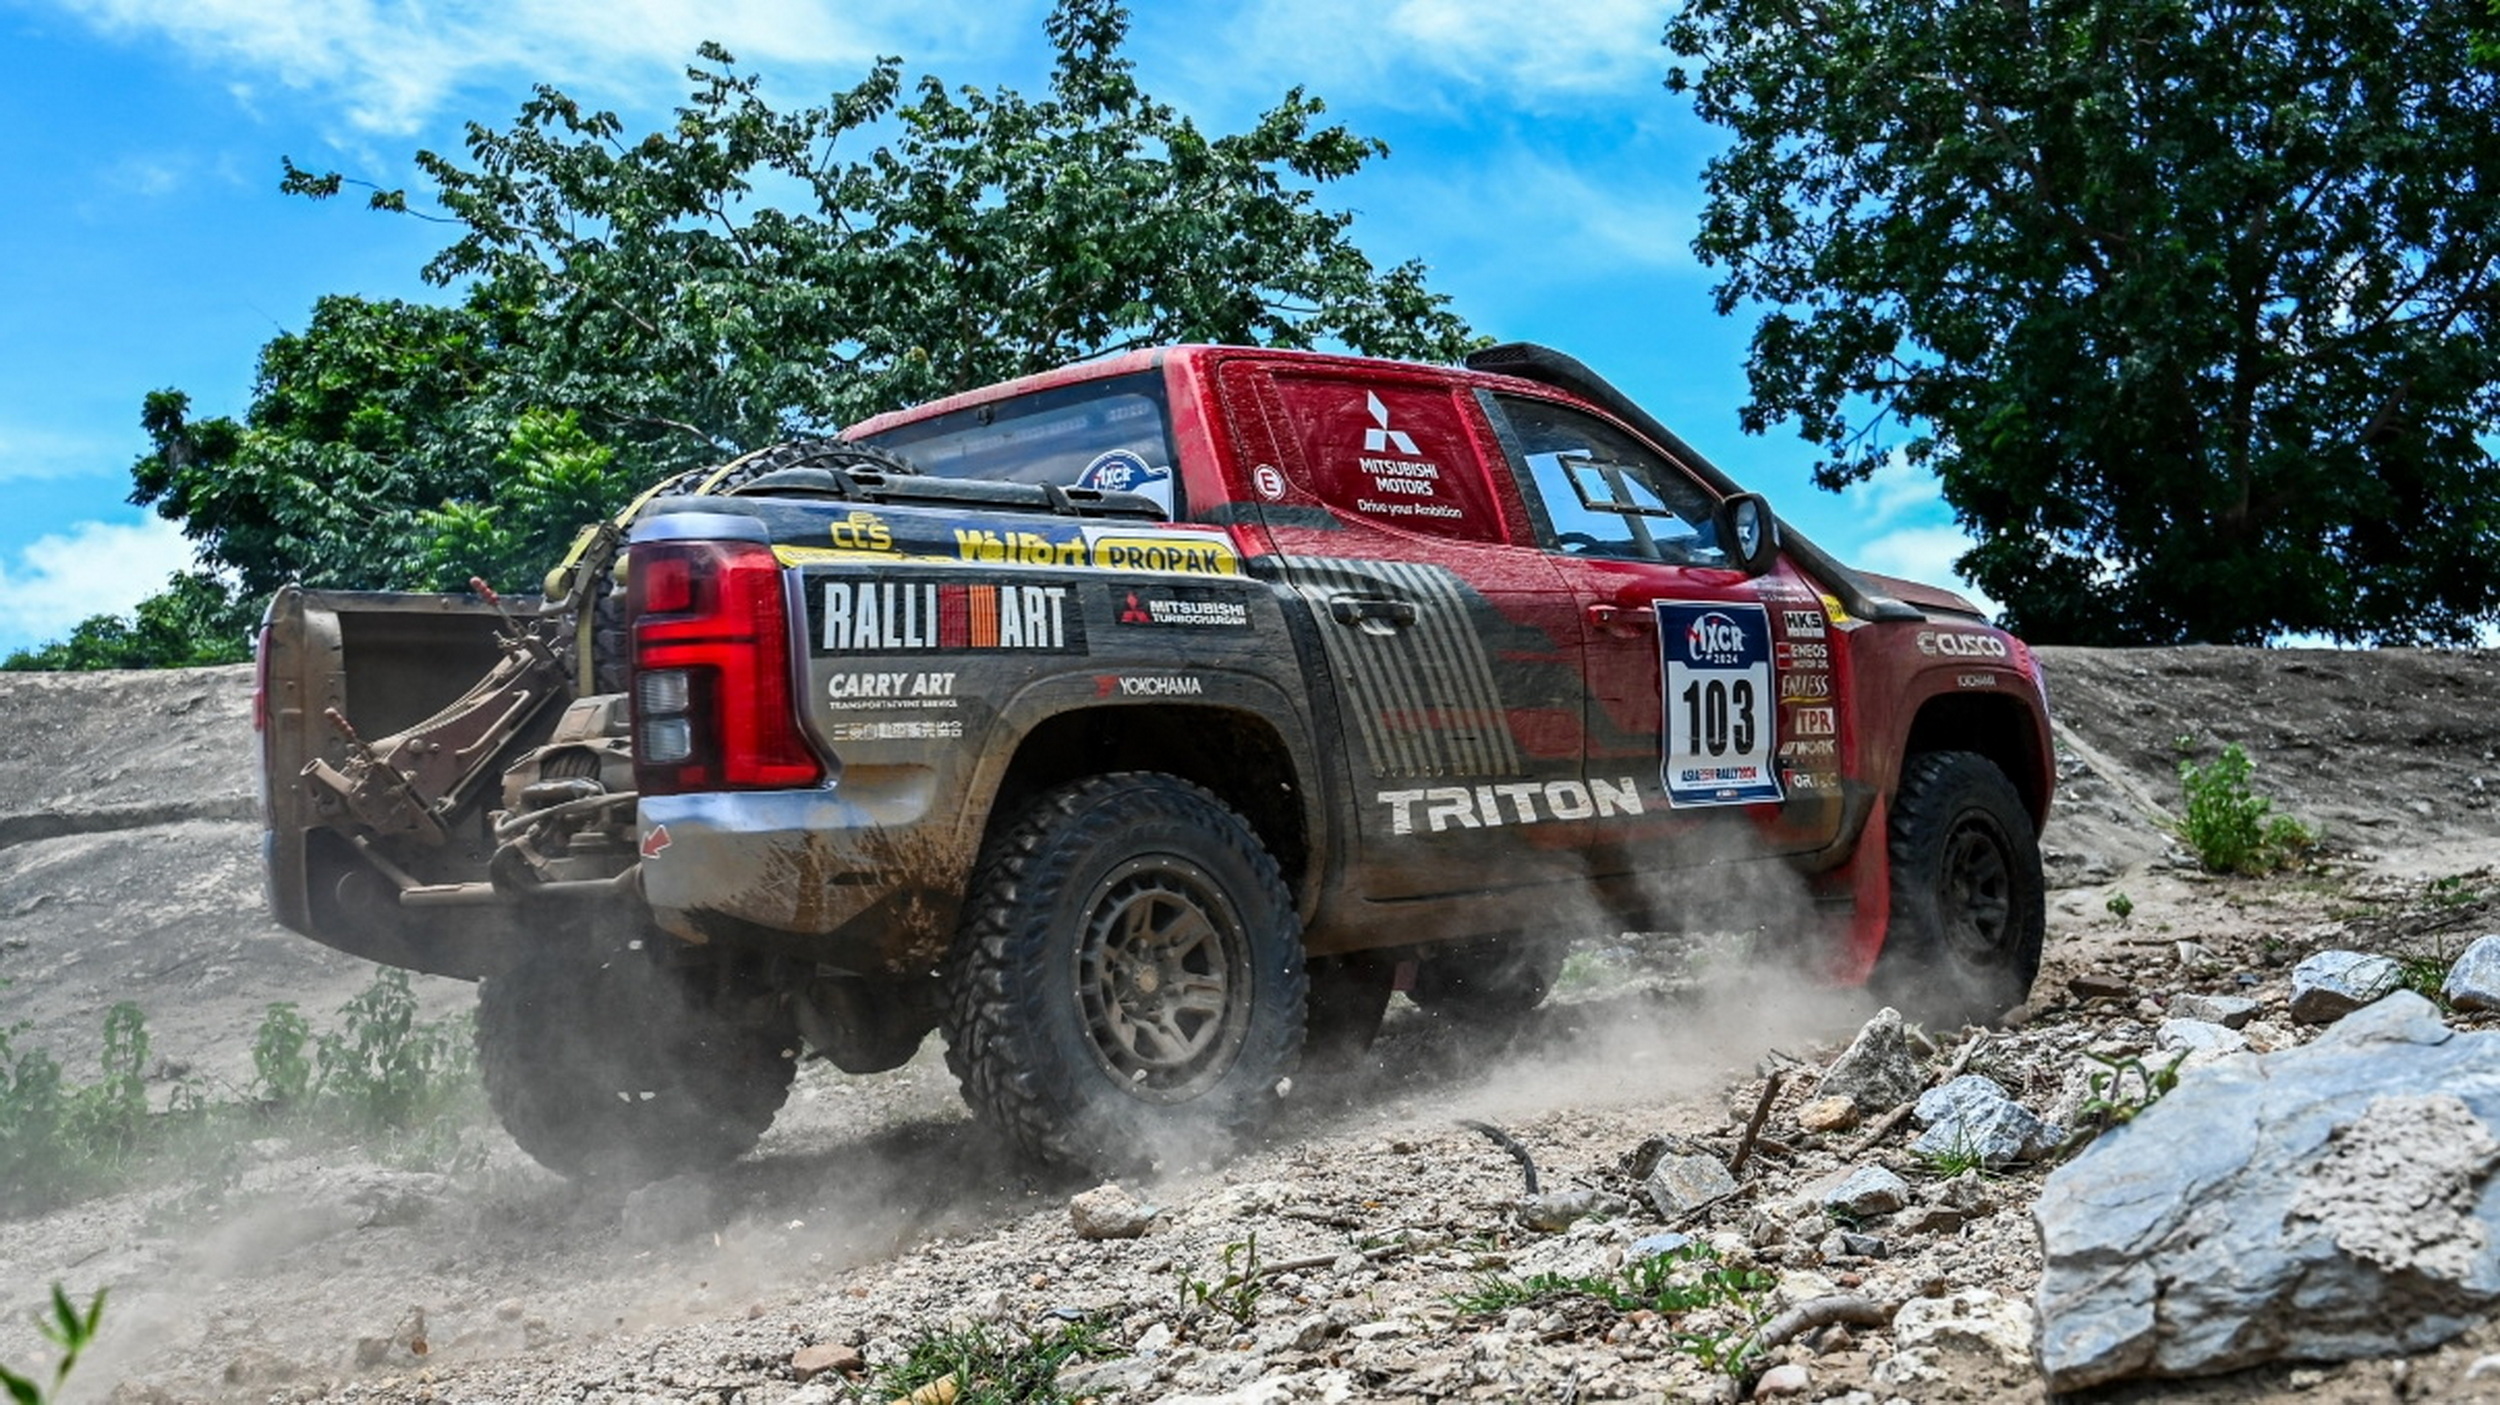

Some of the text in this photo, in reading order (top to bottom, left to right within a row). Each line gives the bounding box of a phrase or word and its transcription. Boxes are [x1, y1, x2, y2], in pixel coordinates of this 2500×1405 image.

[1359, 457, 1439, 479] MITSUBISHI
[1374, 476, 1433, 496] MOTORS
[1357, 498, 1462, 518] Drive your Ambition
[1108, 545, 1221, 575] PROPAK
[1150, 600, 1245, 616] MITSUBISHI
[1785, 612, 1822, 629] HKS
[1791, 644, 1828, 658] ENEOS
[1936, 633, 2006, 657] CUSCO
[1714, 653, 1738, 664] 2024
[828, 672, 956, 698] CARRY ART
[1118, 676, 1202, 696] YOKOHAMA
[1683, 679, 1755, 758] 103
[1799, 709, 1832, 733] TPR
[1797, 740, 1834, 756] WORK
[1377, 776, 1644, 836] TRITON
